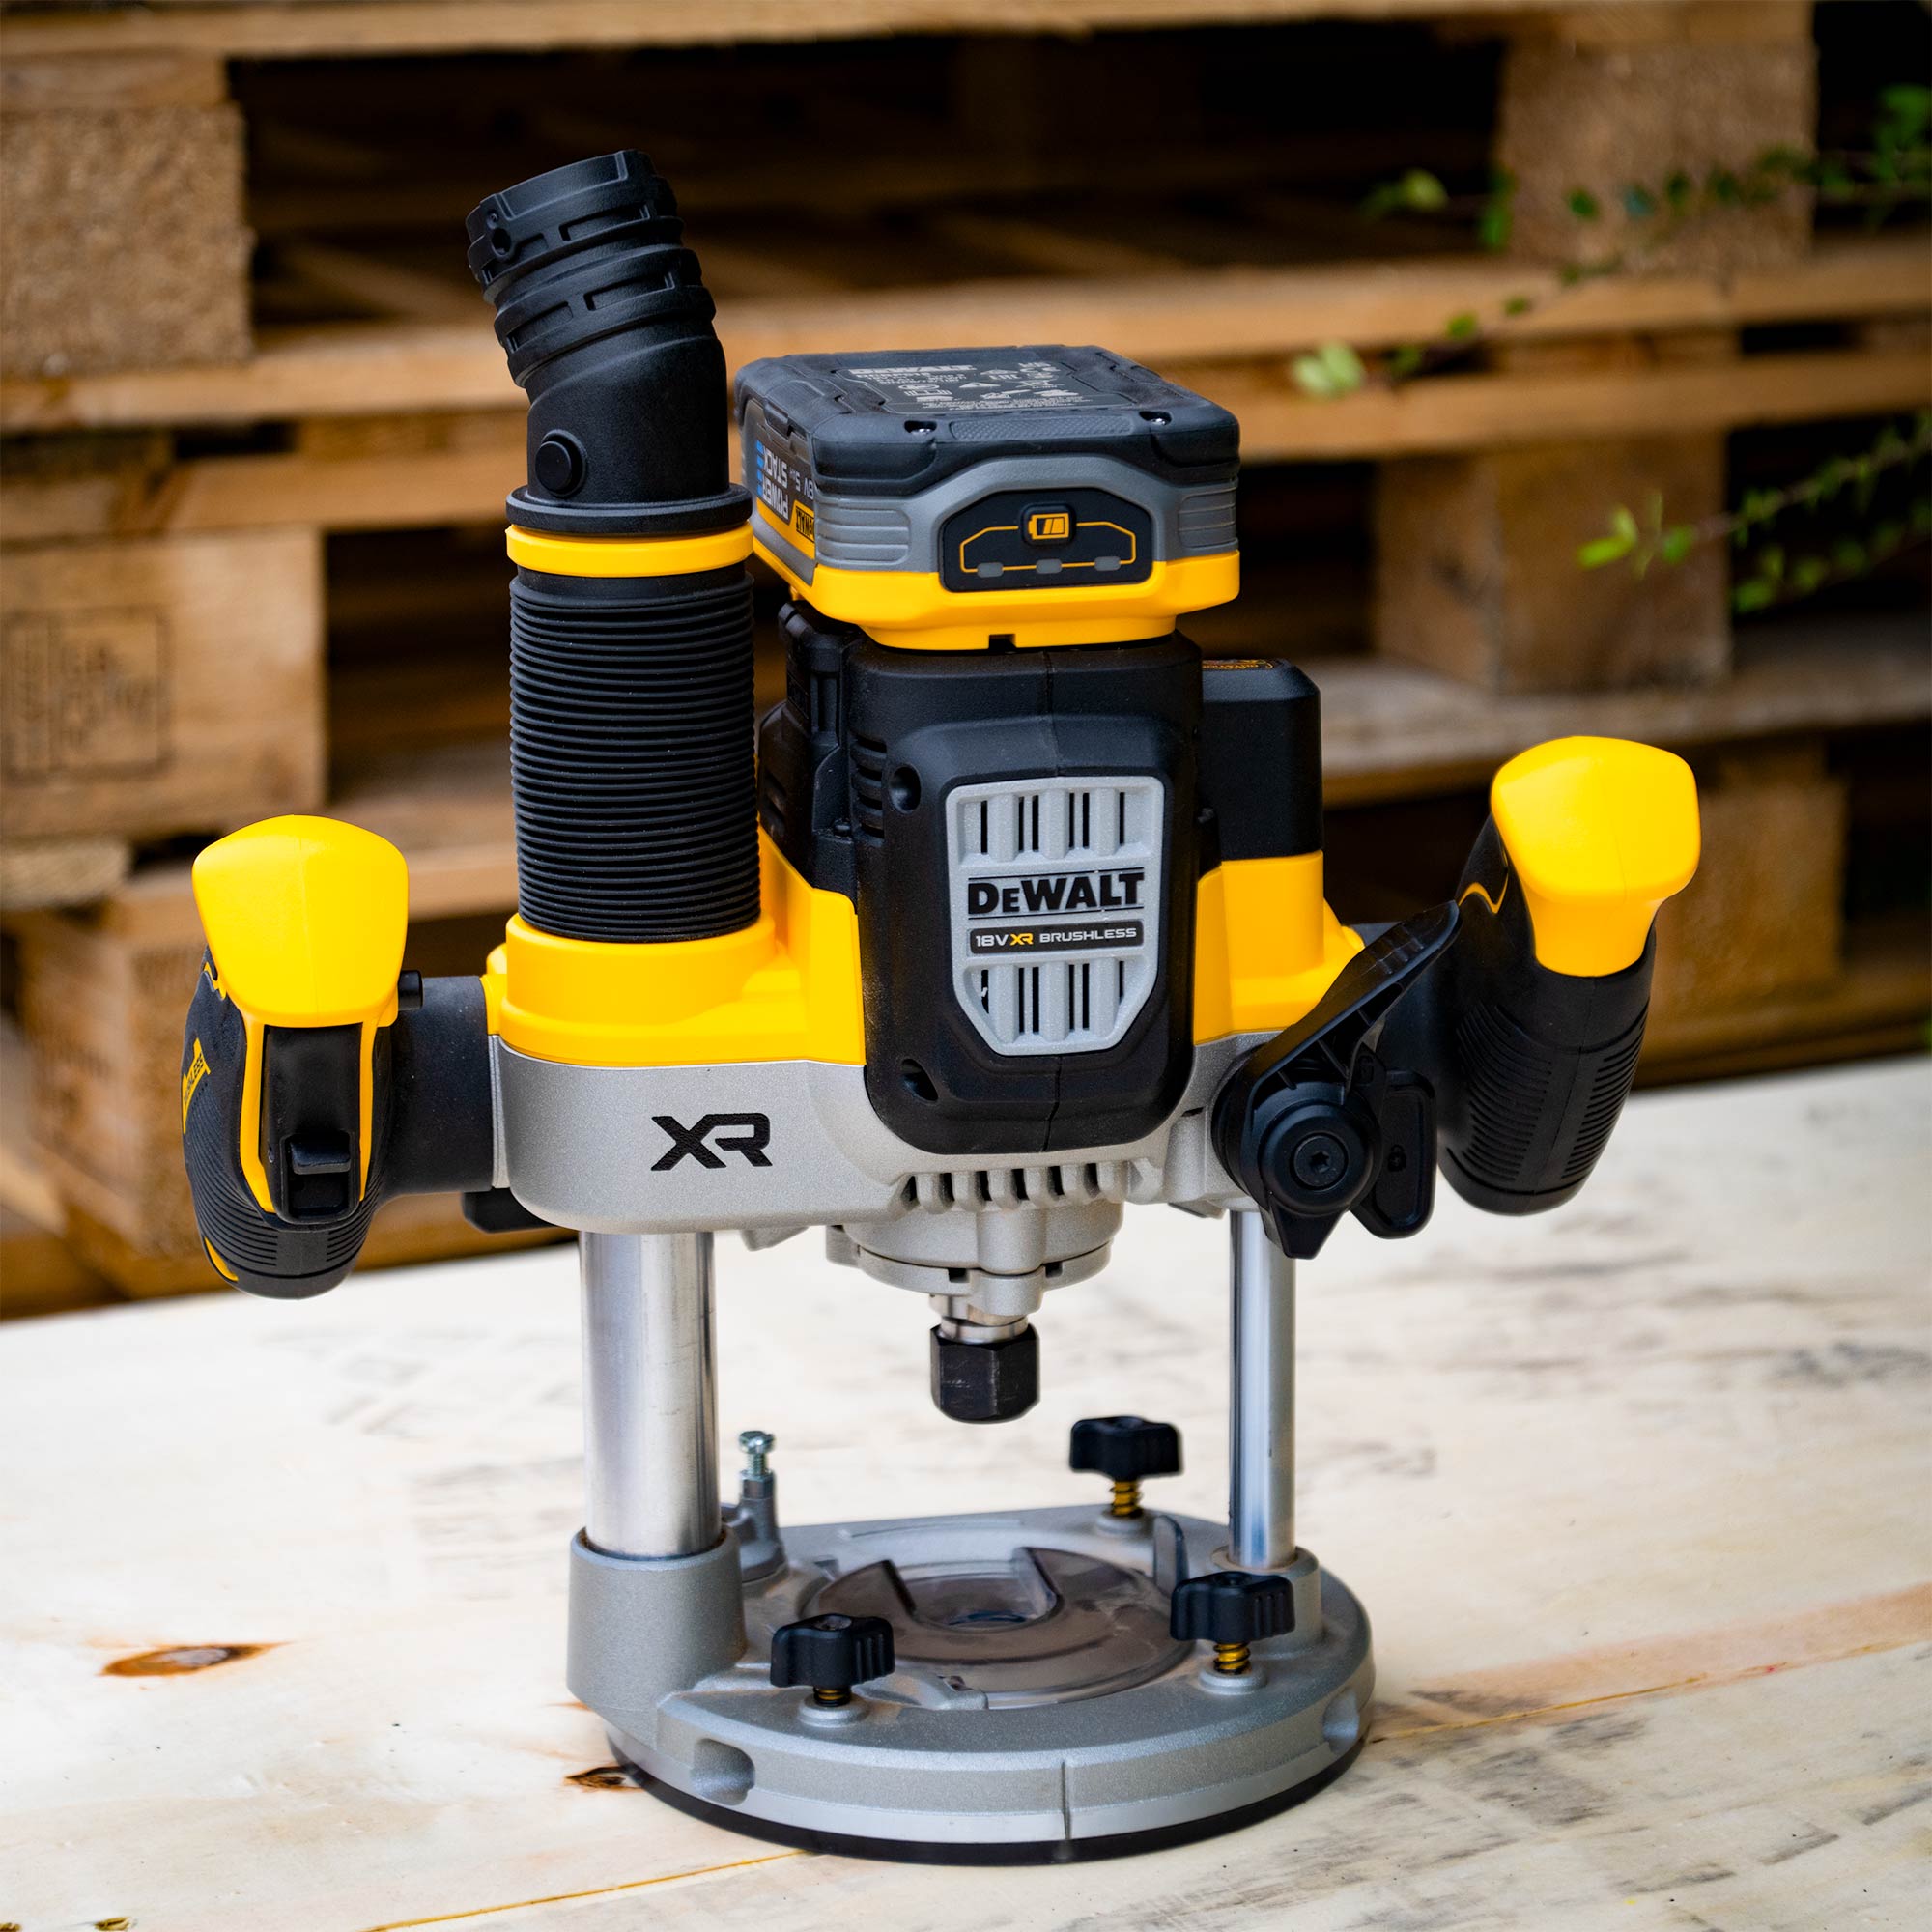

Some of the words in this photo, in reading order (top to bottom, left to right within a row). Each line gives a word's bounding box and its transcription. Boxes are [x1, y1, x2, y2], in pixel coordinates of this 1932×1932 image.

[763, 475, 789, 520] POWER
[1039, 927, 1137, 943] BRUSHLESS
[650, 1113, 773, 1171] XR
